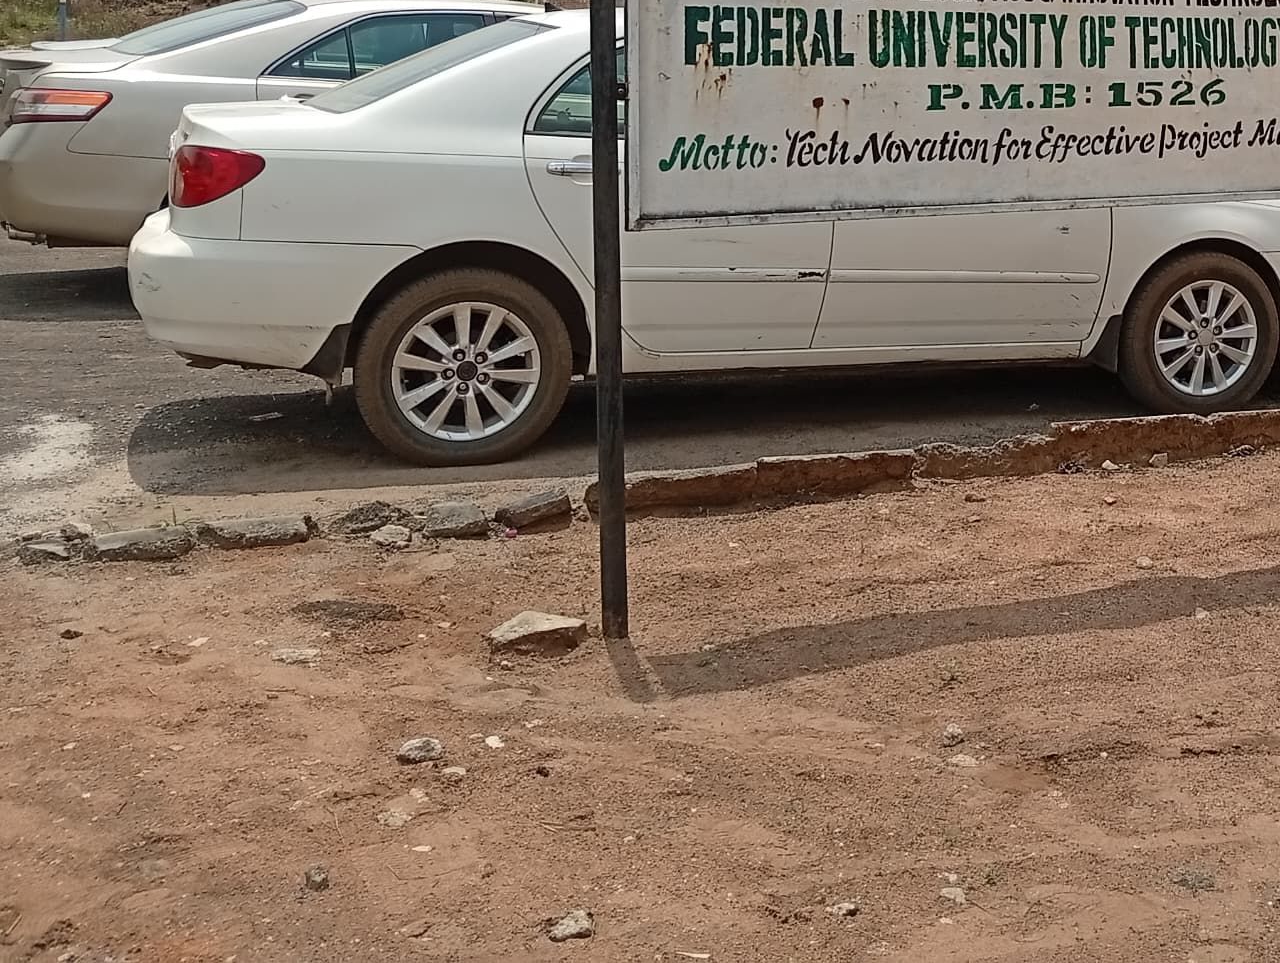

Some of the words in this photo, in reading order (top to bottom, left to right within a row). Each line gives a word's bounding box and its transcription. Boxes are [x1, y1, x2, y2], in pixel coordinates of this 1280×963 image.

[684, 5, 855, 67] FEDERAL
[868, 8, 1069, 69] UNIVERSITY
[1079, 15, 1116, 69] OF
[1107, 79, 1227, 108] 1526
[658, 134, 779, 172] Motto:
[853, 128, 991, 166] Novation
[991, 127, 1033, 166] for
[1034, 125, 1155, 163] Effective
